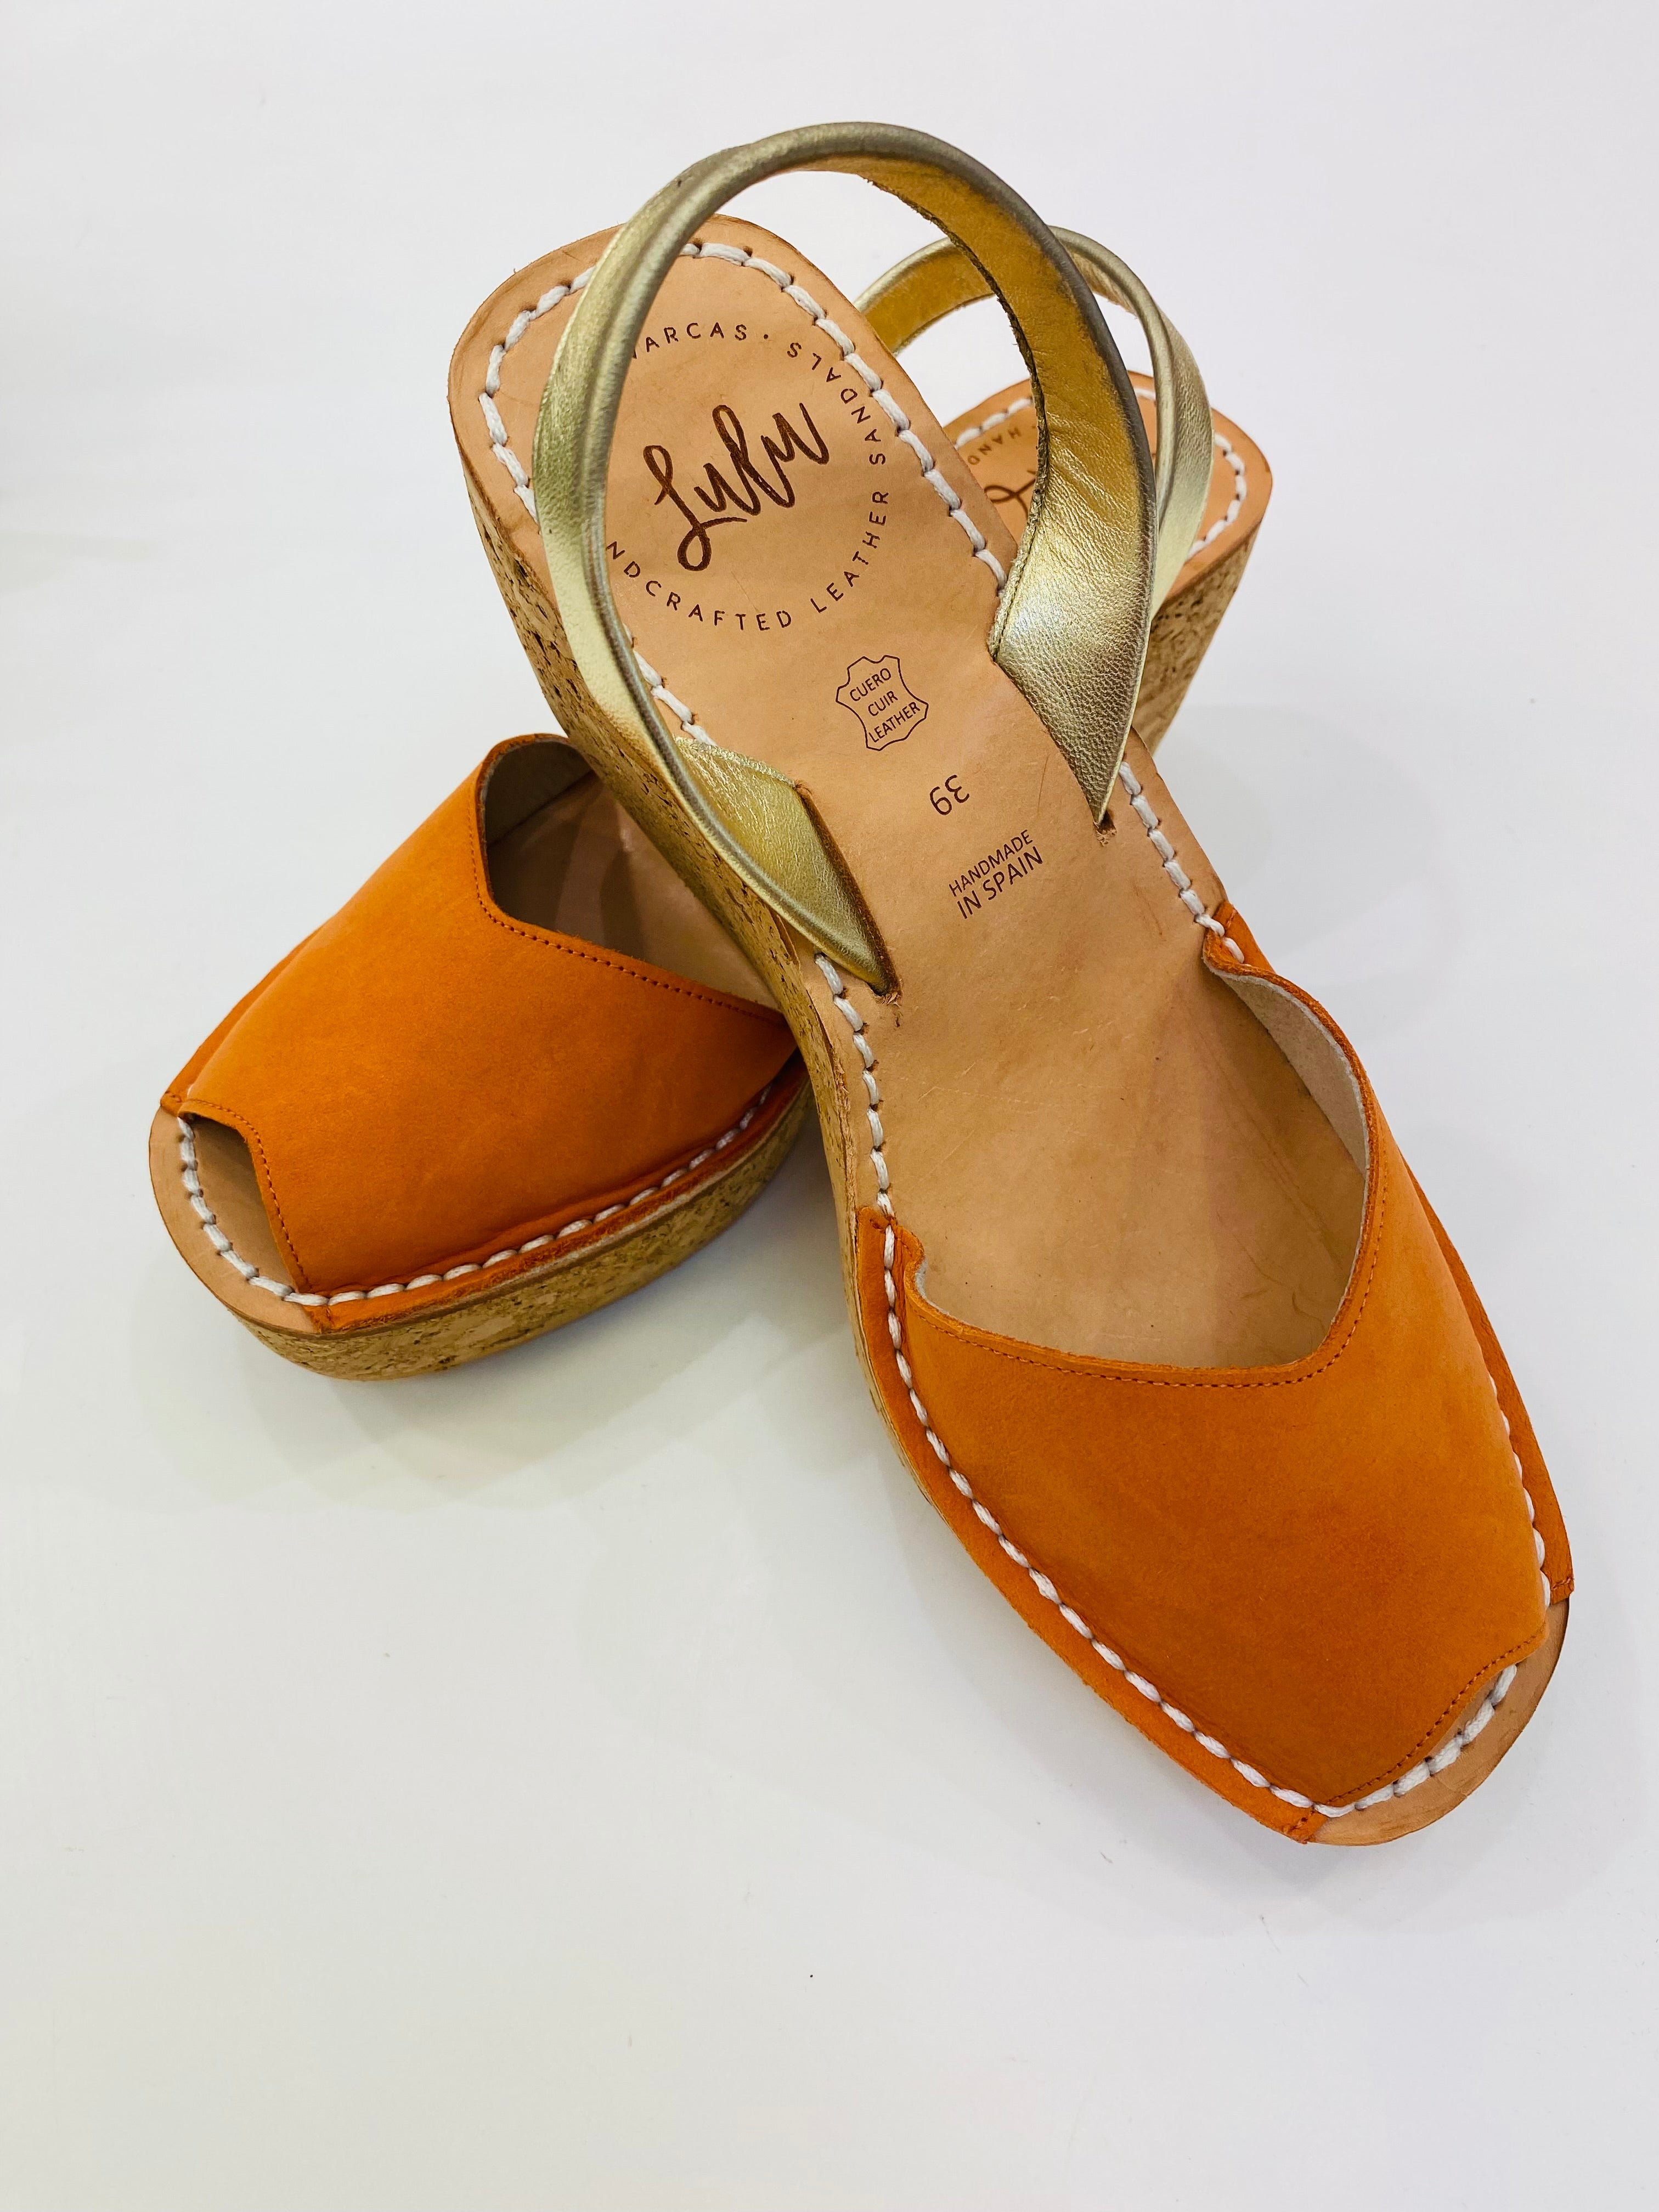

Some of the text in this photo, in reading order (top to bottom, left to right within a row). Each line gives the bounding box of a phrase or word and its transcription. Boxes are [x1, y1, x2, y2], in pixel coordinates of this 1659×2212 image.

[633, 322, 747, 359] ARCAS
[968, 426, 1022, 465] HAND
[605, 342, 889, 631] NDCRAFTED LEATHER SANDALS
[643, 402, 830, 572] Lulu
[849, 668, 891, 702] CUERO
[868, 690, 899, 716] CUIR
[868, 701, 921, 743] LEATHER
[929, 774, 970, 816] 39
[949, 829, 1033, 898] HANDMADE
[957, 846, 1043, 919] IN SPAIN
